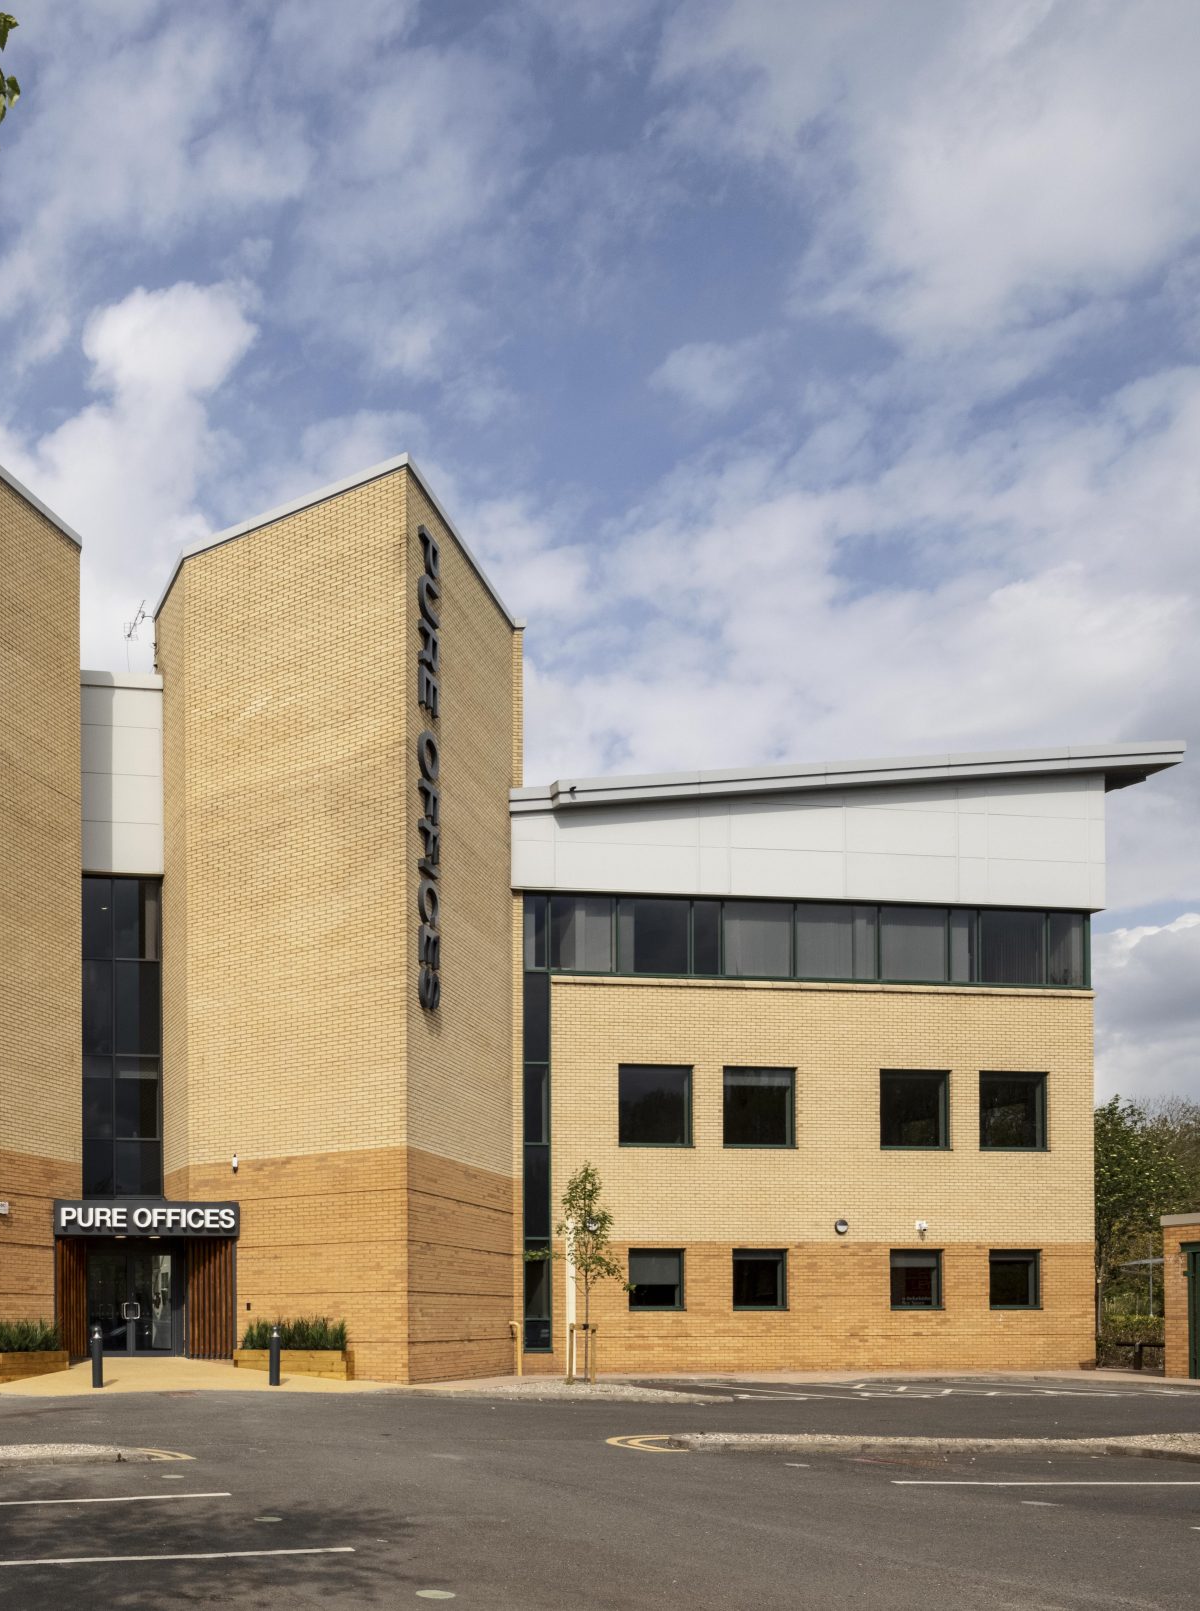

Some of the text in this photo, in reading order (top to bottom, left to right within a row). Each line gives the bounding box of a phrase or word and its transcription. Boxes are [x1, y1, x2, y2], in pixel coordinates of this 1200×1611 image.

[418, 525, 440, 1010] PURE OFFICES
[61, 1208, 235, 1229] PURE OFFICES
